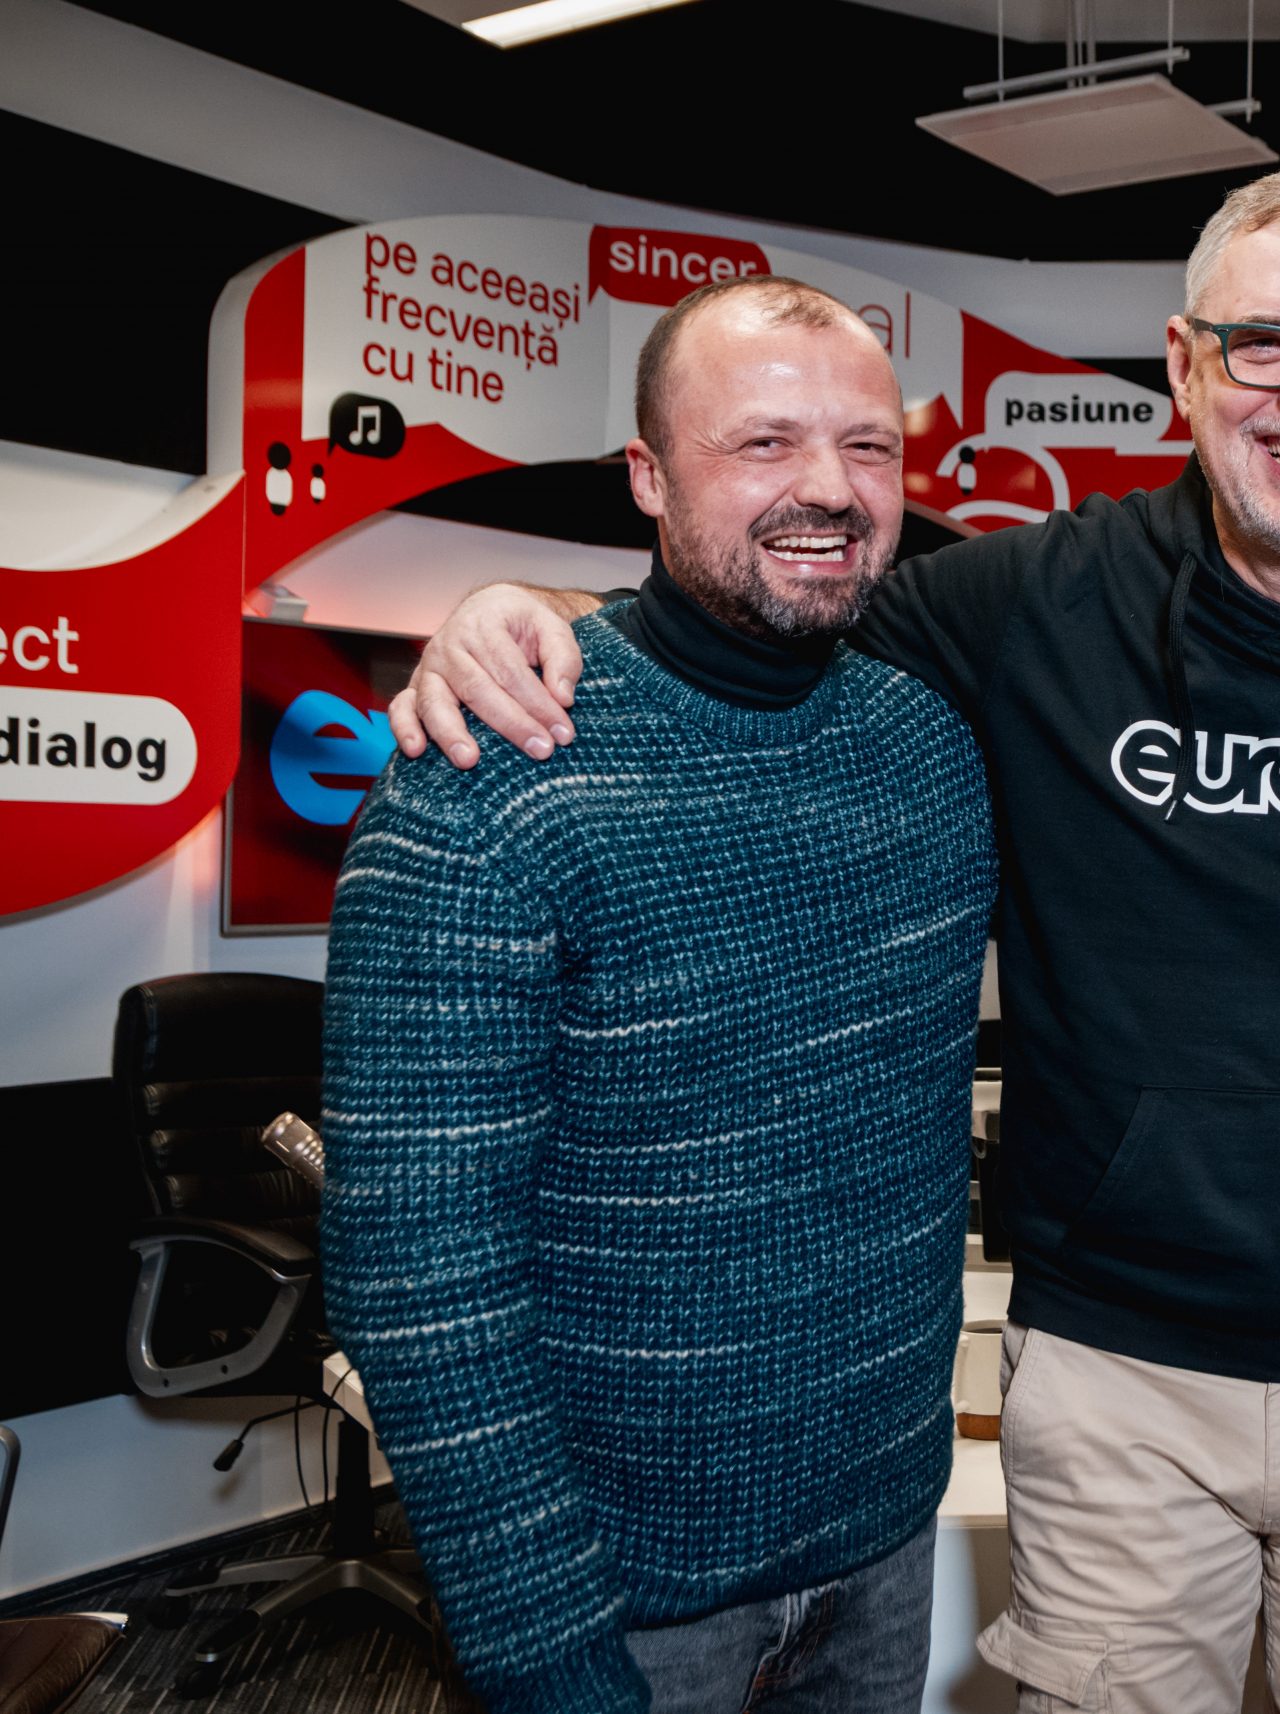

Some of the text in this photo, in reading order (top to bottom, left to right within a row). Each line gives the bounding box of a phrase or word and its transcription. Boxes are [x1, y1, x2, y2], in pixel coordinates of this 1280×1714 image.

[365, 231, 581, 330] pe aceeași
[608, 234, 757, 283] sincer
[362, 276, 559, 372] frecvență
[362, 342, 505, 404] cu tine
[1004, 393, 1154, 427] pasiune
[0, 616, 80, 674] ct
[0, 716, 167, 783] dialog
